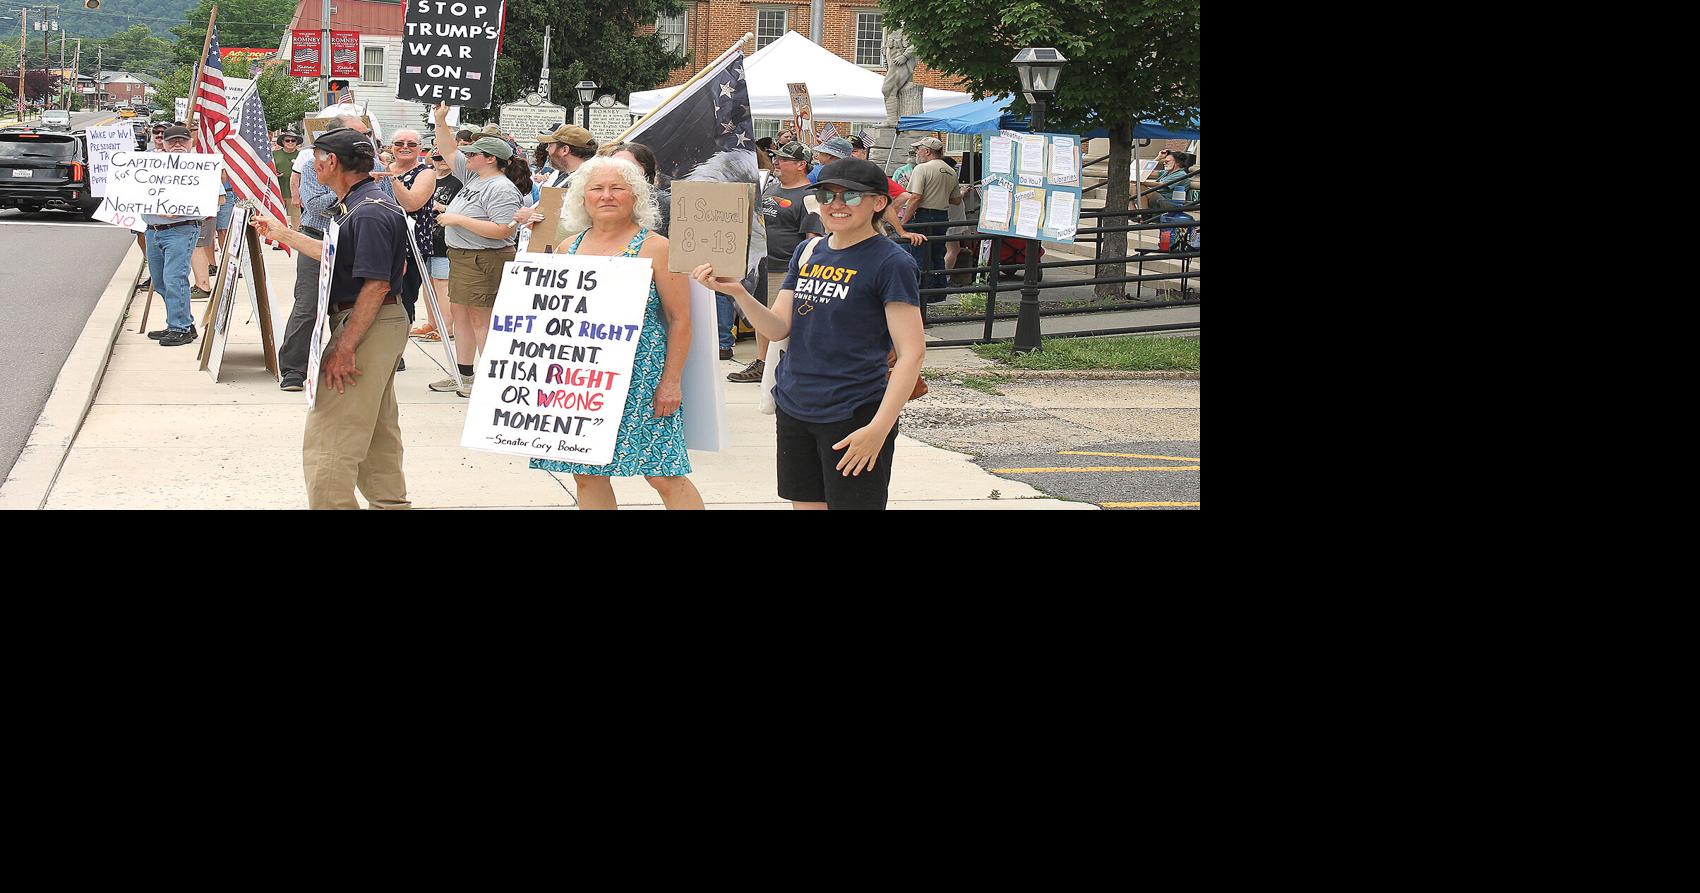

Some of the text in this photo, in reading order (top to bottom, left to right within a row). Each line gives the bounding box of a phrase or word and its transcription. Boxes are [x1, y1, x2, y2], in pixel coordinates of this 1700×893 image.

[418, 0, 487, 18] STOP
[406, 21, 498, 39] TRUMP'S
[408, 42, 473, 58] WAR
[426, 64, 462, 79] ON
[414, 83, 472, 101] VETS
[539, 82, 548, 94] 50
[90, 129, 106, 139] WAKE
[108, 131, 116, 139] UP
[114, 168, 200, 186] for CONGRESS
[998, 178, 1013, 190] Arts
[1028, 177, 1042, 185] You?
[147, 187, 166, 196] OF
[104, 196, 201, 215] NORTH KOREA
[676, 196, 745, 224] 1 Samuel
[110, 212, 136, 227] NO
[576, 270, 598, 291] IS
[799, 263, 858, 283] LMOST
[794, 292, 831, 304] OMNEY, WV
[795, 278, 850, 300] EAVEN
[532, 293, 588, 314] NOT A
[492, 314, 640, 342] LEFT OR RIGHT
[509, 338, 603, 364] MOMENT.
[488, 360, 508, 379] IT
[545, 363, 622, 391] RIGHT
[501, 385, 604, 412] OR WRONG
[531, 436, 552, 452] Cory
[557, 439, 592, 454] Booker
